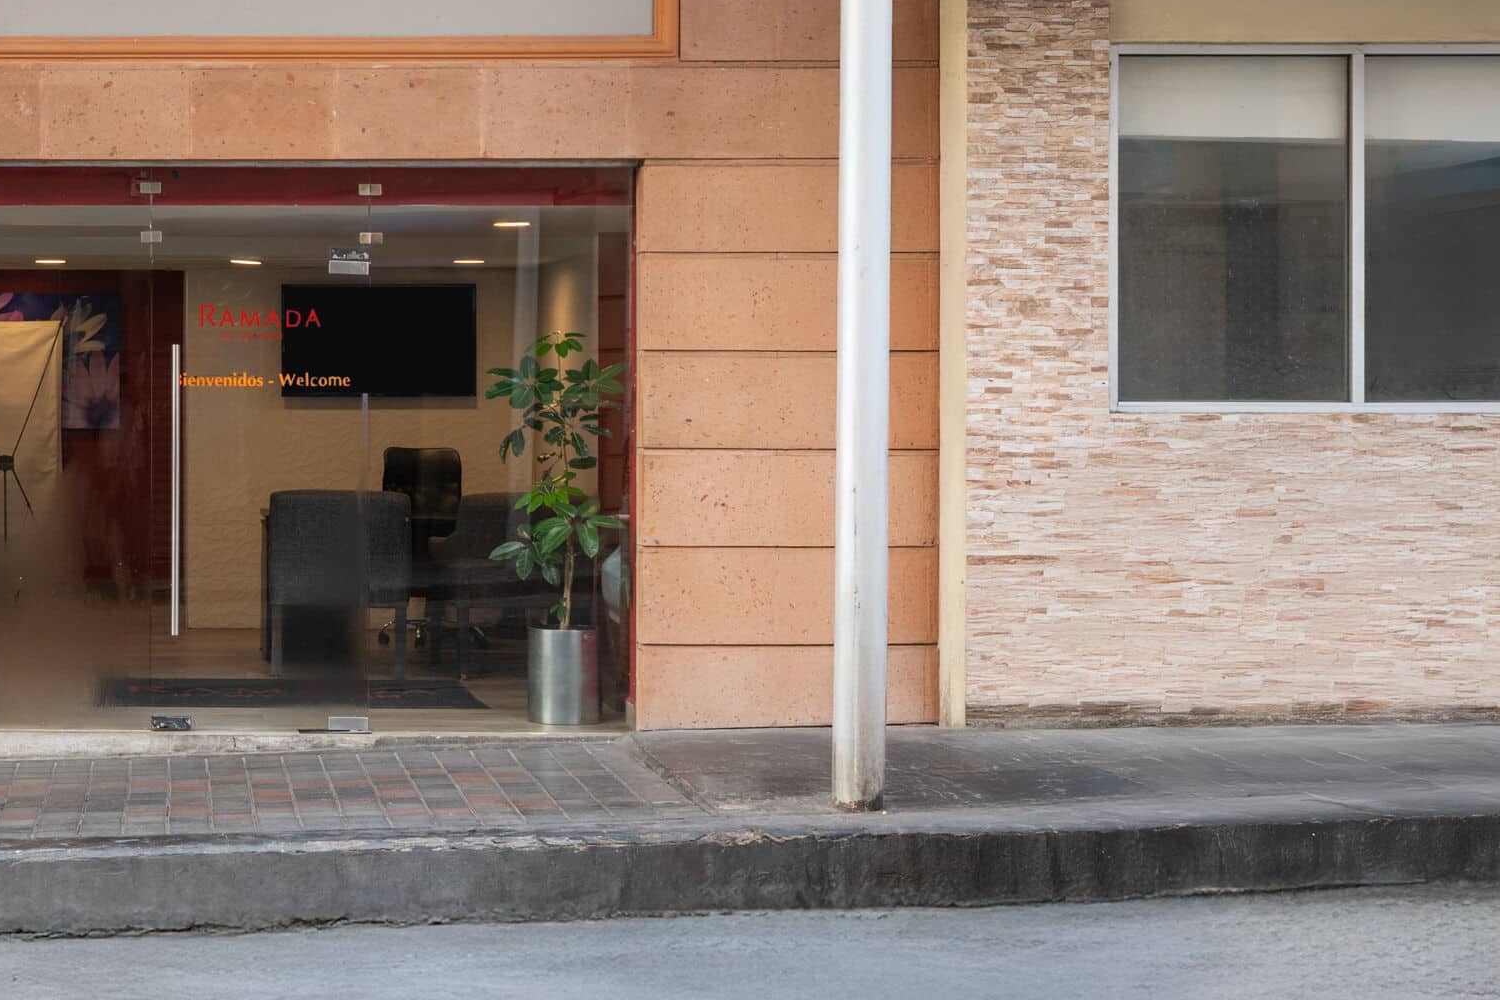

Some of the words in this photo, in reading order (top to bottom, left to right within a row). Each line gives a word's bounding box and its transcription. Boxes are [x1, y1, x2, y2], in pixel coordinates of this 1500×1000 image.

[200, 303, 322, 329] RAMADA
[179, 371, 264, 388] ienvenidos
[278, 371, 351, 388] Welcome
